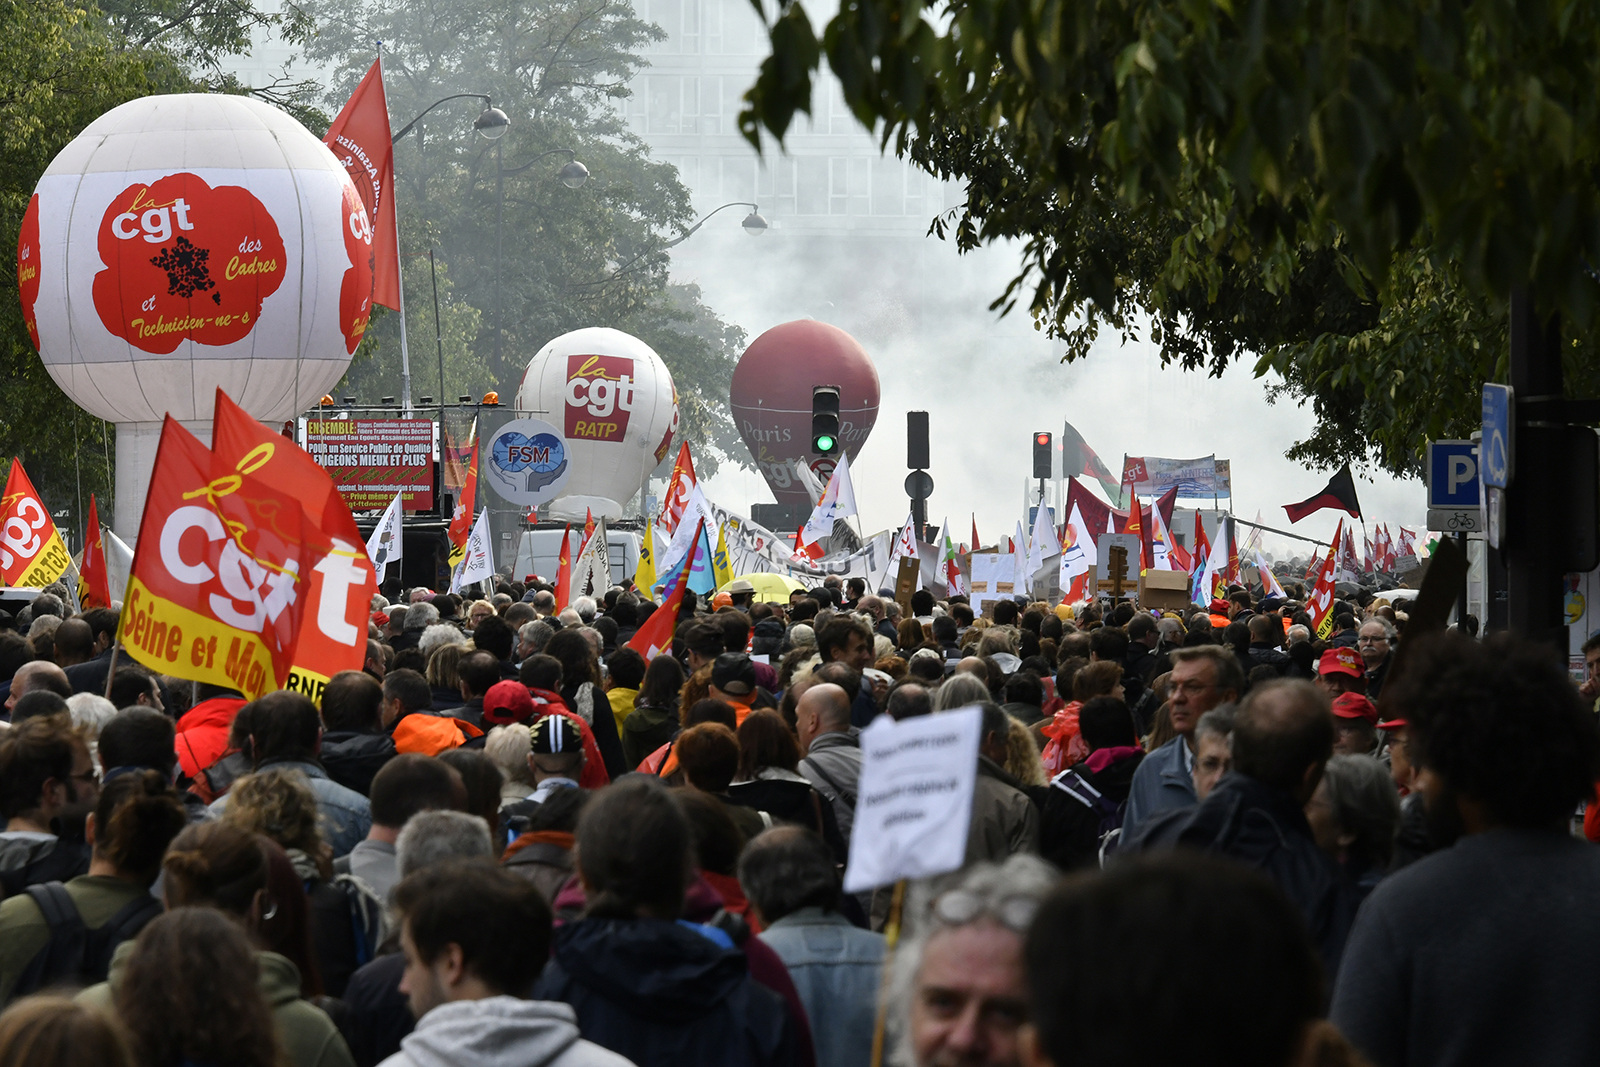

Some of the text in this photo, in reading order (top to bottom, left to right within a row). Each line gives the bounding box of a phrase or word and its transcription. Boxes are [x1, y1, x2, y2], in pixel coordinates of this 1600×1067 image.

[126, 188, 180, 214] la
[112, 198, 194, 243] cgt
[349, 211, 372, 245] cg
[238, 236, 262, 253] des
[225, 255, 277, 280] Cadres
[141, 294, 156, 311] et
[131, 311, 250, 339] Technicien-ne-s
[570, 355, 626, 380] la
[565, 375, 634, 417] cgt
[574, 421, 617, 438] RATP
[743, 420, 792, 442] Paris
[838, 421, 874, 442] Pari
[308, 443, 431, 454] POUR un Service Public de Qualité
[360, 454, 389, 466] MIEUX
[390, 454, 401, 466] ET
[402, 454, 426, 466] PLUS
[508, 446, 550, 463] FSM
[1448, 455, 1476, 495] P
[124, 588, 182, 663] Seine
[191, 635, 218, 669] et
